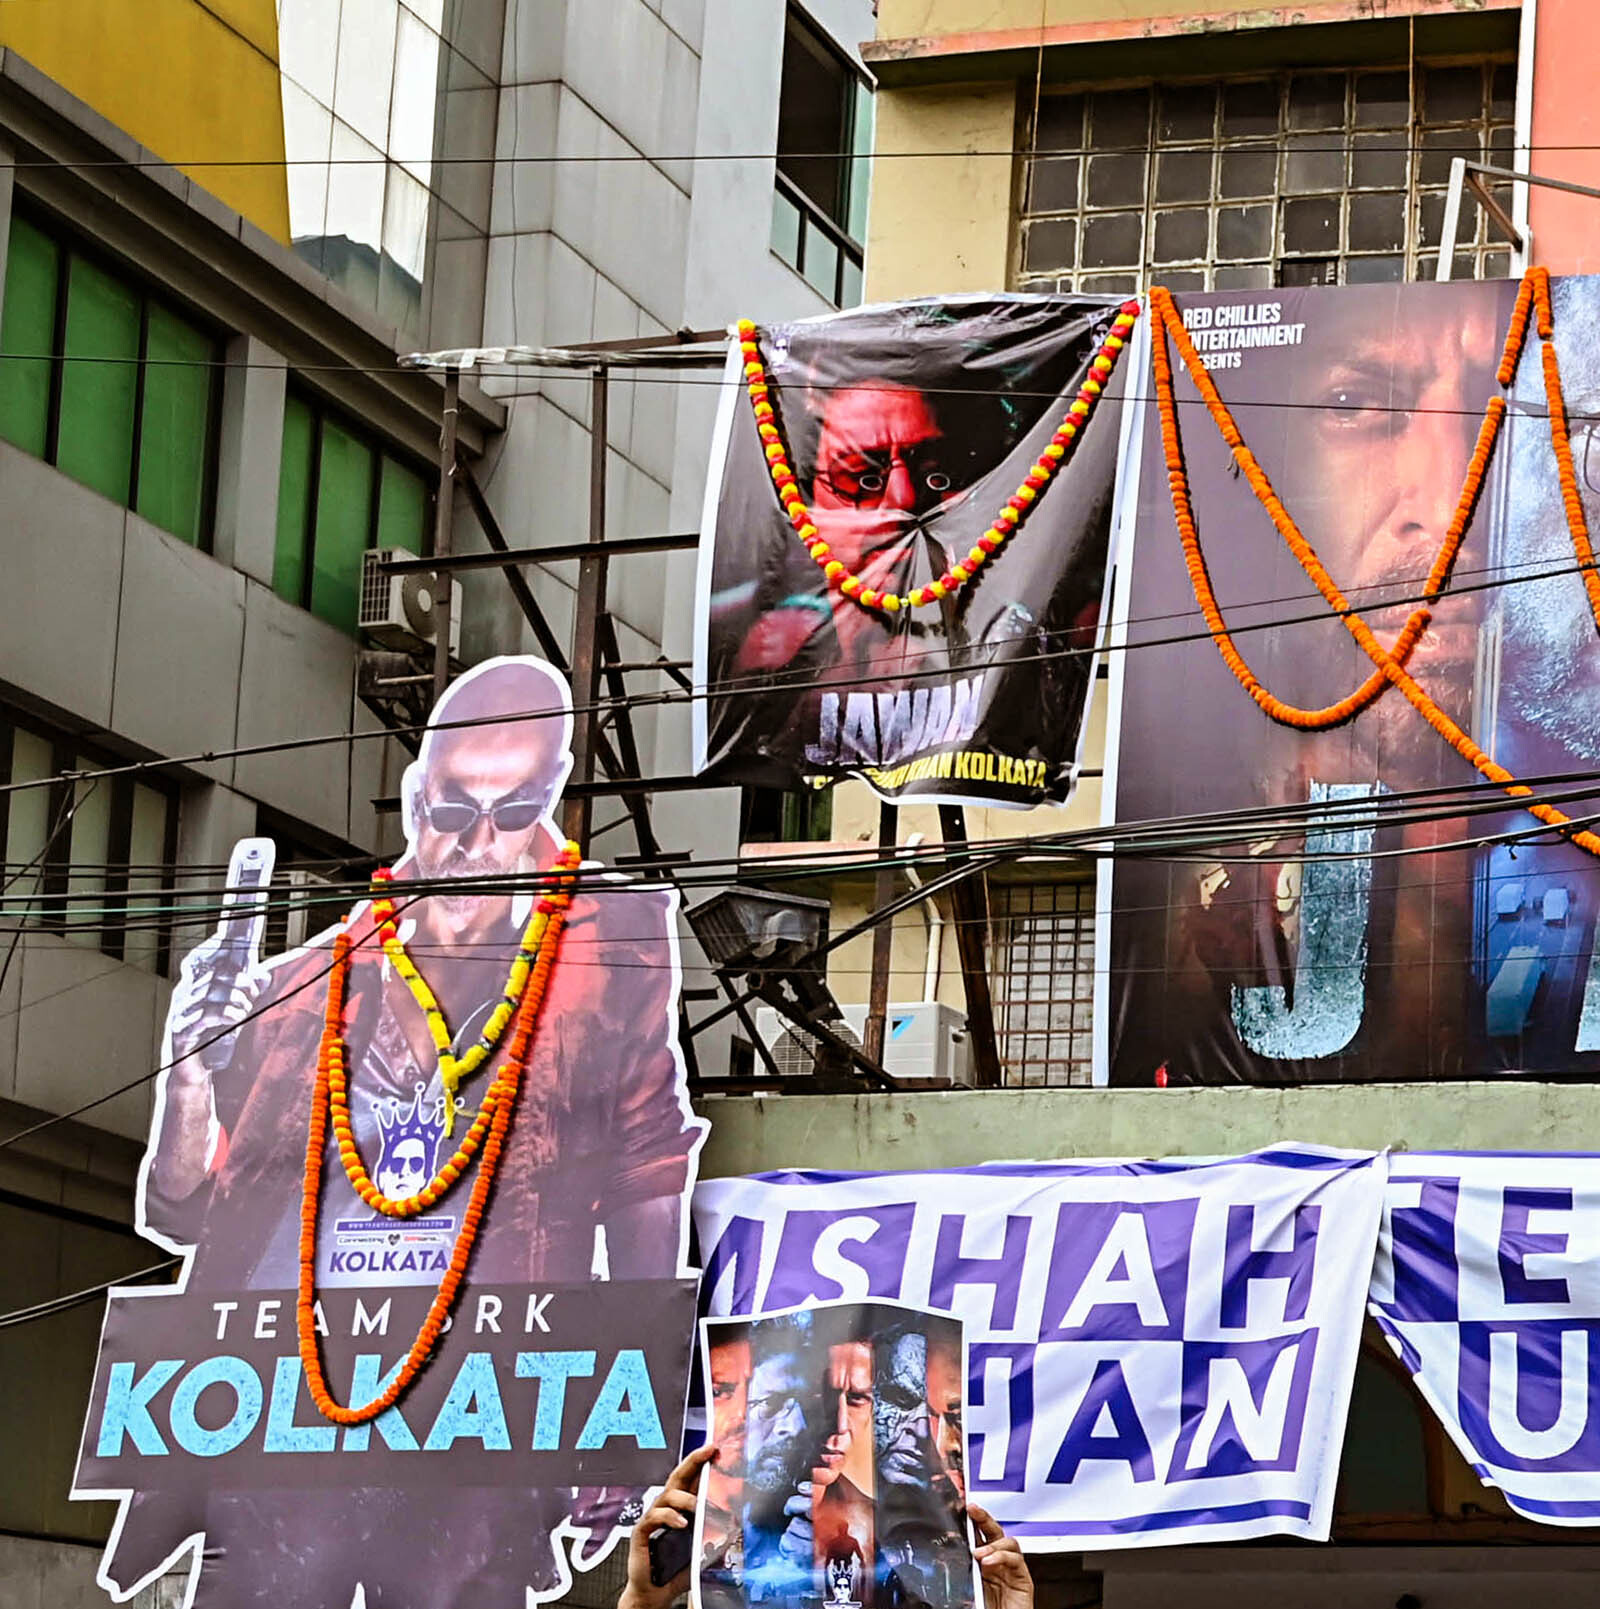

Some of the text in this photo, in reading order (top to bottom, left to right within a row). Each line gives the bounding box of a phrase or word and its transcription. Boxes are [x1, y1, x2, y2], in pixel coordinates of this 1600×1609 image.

[1183, 302, 1282, 329] RED CHILLIES
[1188, 323, 1306, 351] NTERTAINMENT
[1179, 351, 1242, 371] PSENTS
[803, 674, 985, 766] JAWAN
[955, 751, 1048, 789] KOLKATA
[329, 1249, 449, 1274] KOLKATA
[214, 1297, 391, 1341] TEAM
[96, 1349, 668, 1459] KOLKATA
[969, 1344, 1302, 1486] HAN
